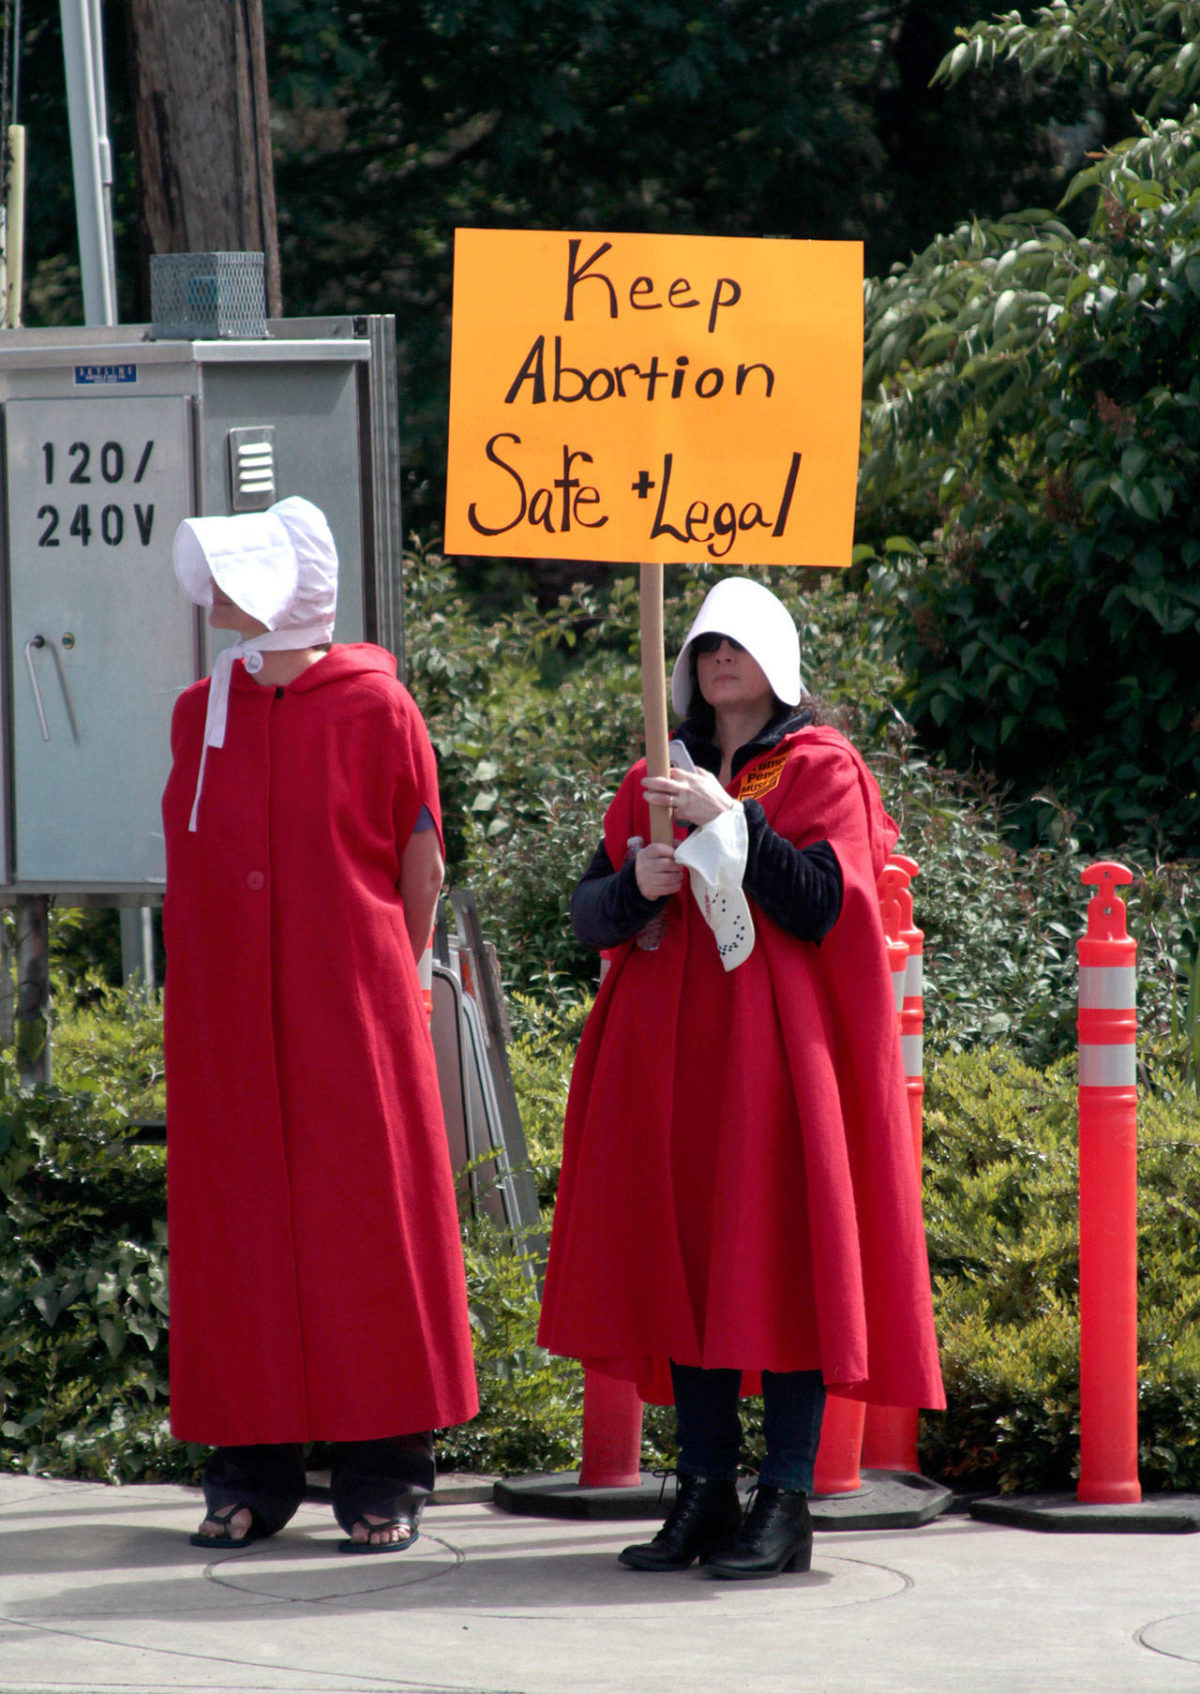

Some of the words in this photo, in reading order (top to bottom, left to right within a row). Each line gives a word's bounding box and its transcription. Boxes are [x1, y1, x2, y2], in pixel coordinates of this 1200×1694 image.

[564, 239, 742, 334] Keep
[504, 335, 776, 405] Abortion
[42, 441, 154, 485] 120/
[468, 432, 610, 537] Safe
[631, 470, 656, 499] +
[650, 451, 803, 558] Legal
[37, 503, 155, 547] 240V
